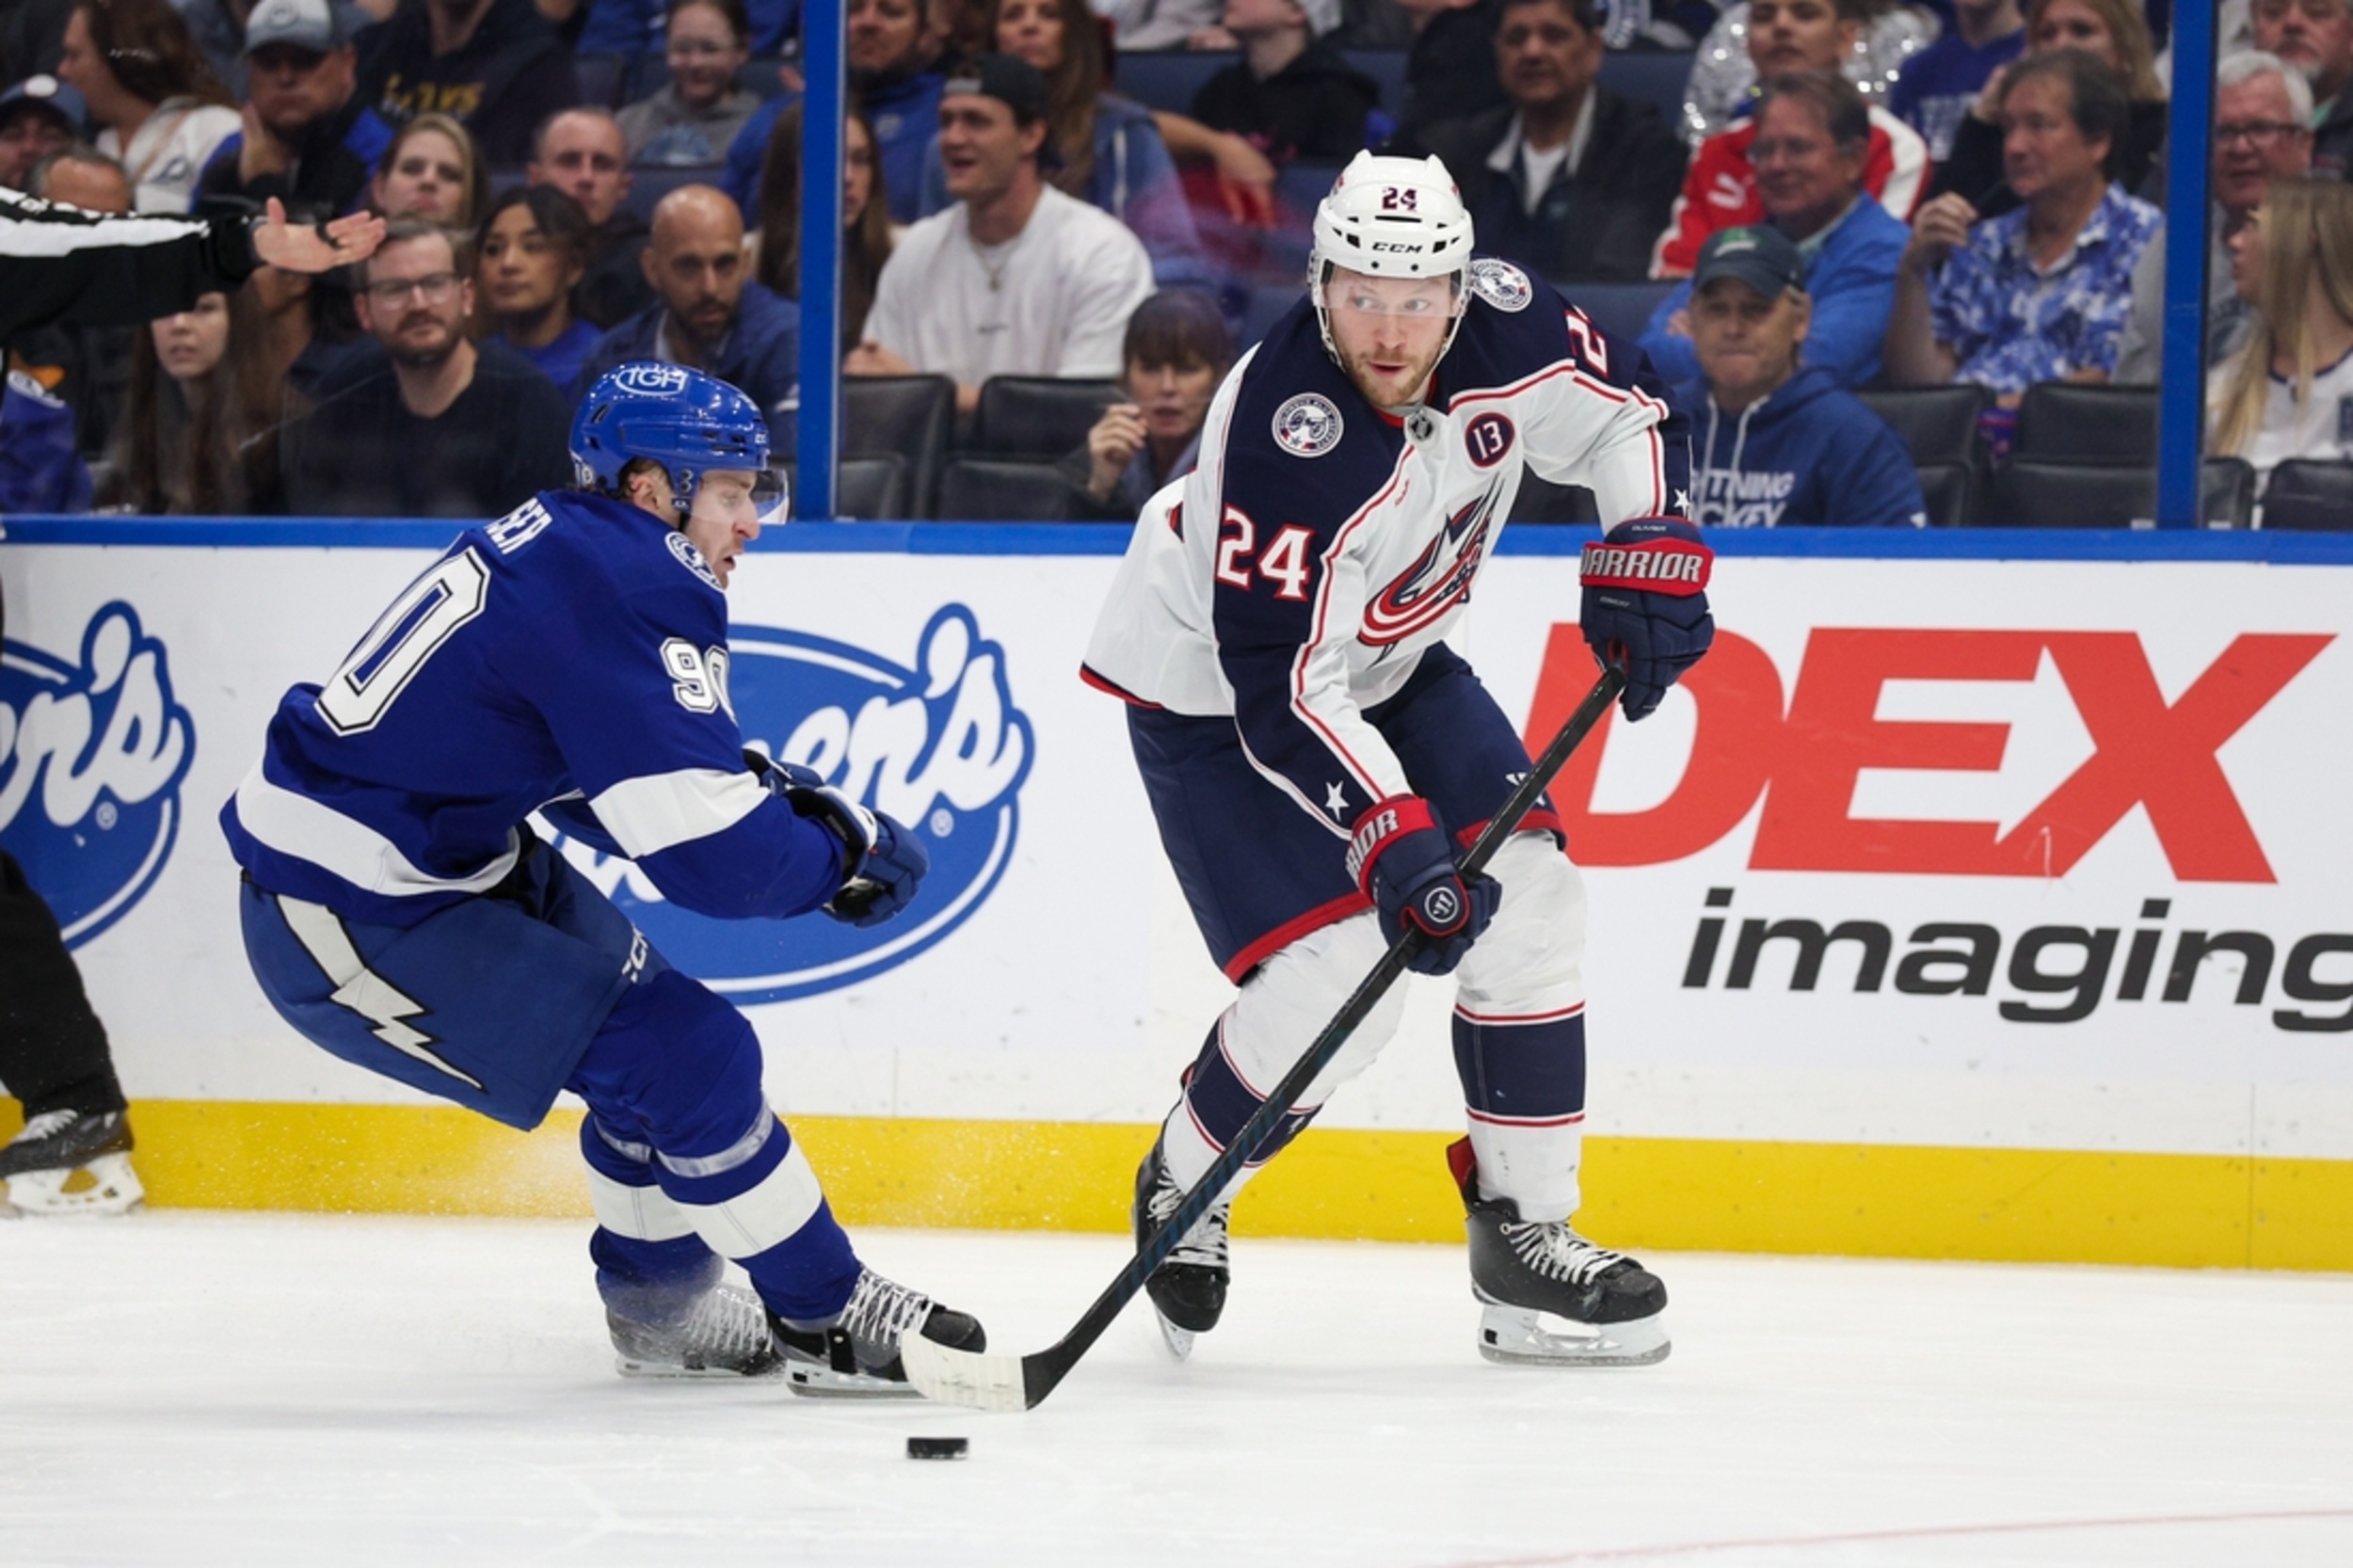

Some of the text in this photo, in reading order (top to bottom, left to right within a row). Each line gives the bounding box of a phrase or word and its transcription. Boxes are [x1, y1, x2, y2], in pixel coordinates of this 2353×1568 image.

[1381, 186, 1417, 212] 24
[1371, 241, 1424, 254] CCM
[1472, 421, 1505, 460] 13
[484, 497, 553, 555] SER
[1214, 503, 1316, 602] 24
[313, 544, 492, 738] 0
[1520, 621, 2338, 884] DEX
[1681, 888, 2353, 1032] imaging
